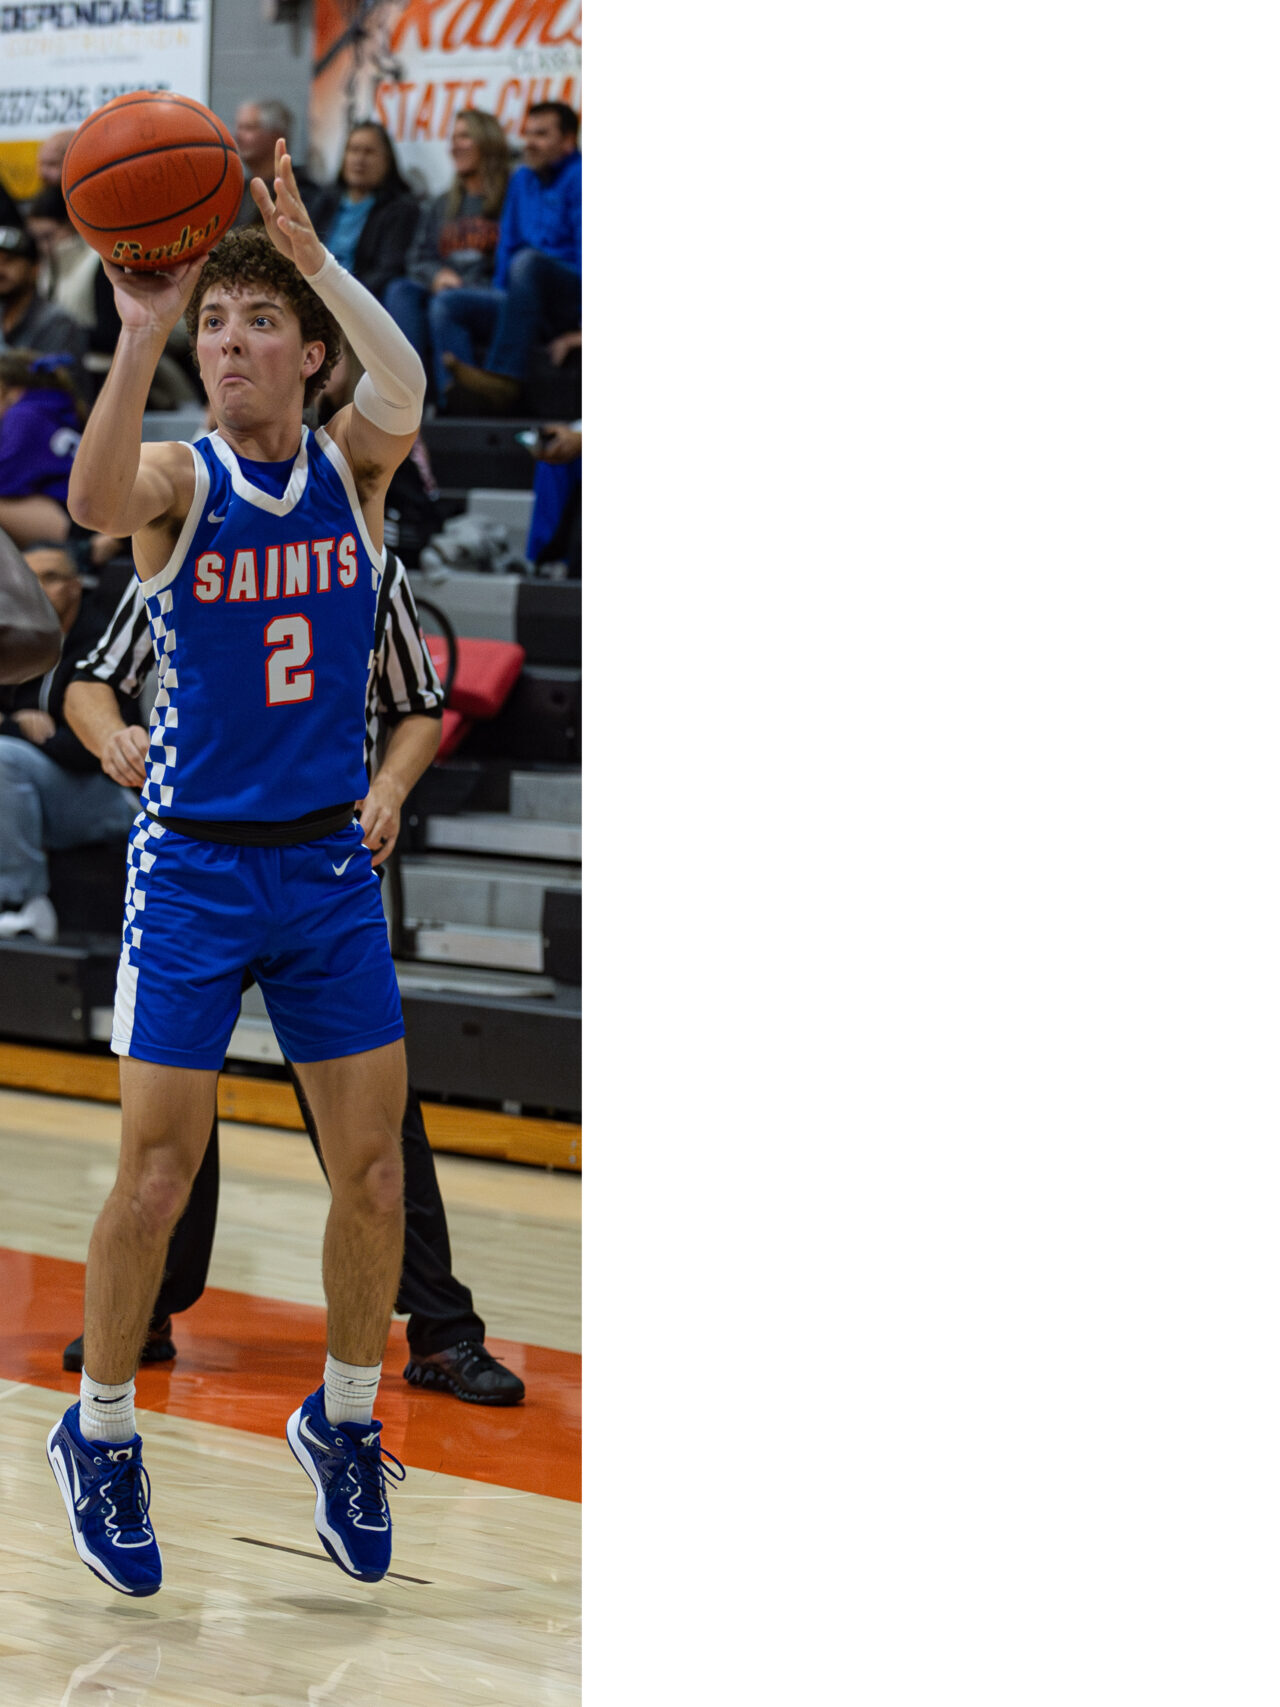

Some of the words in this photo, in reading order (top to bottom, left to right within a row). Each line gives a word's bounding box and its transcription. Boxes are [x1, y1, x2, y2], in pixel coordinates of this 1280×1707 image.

[111, 214, 221, 261] Baden
[193, 532, 358, 603] SAINTS
[264, 613, 315, 707] 2
